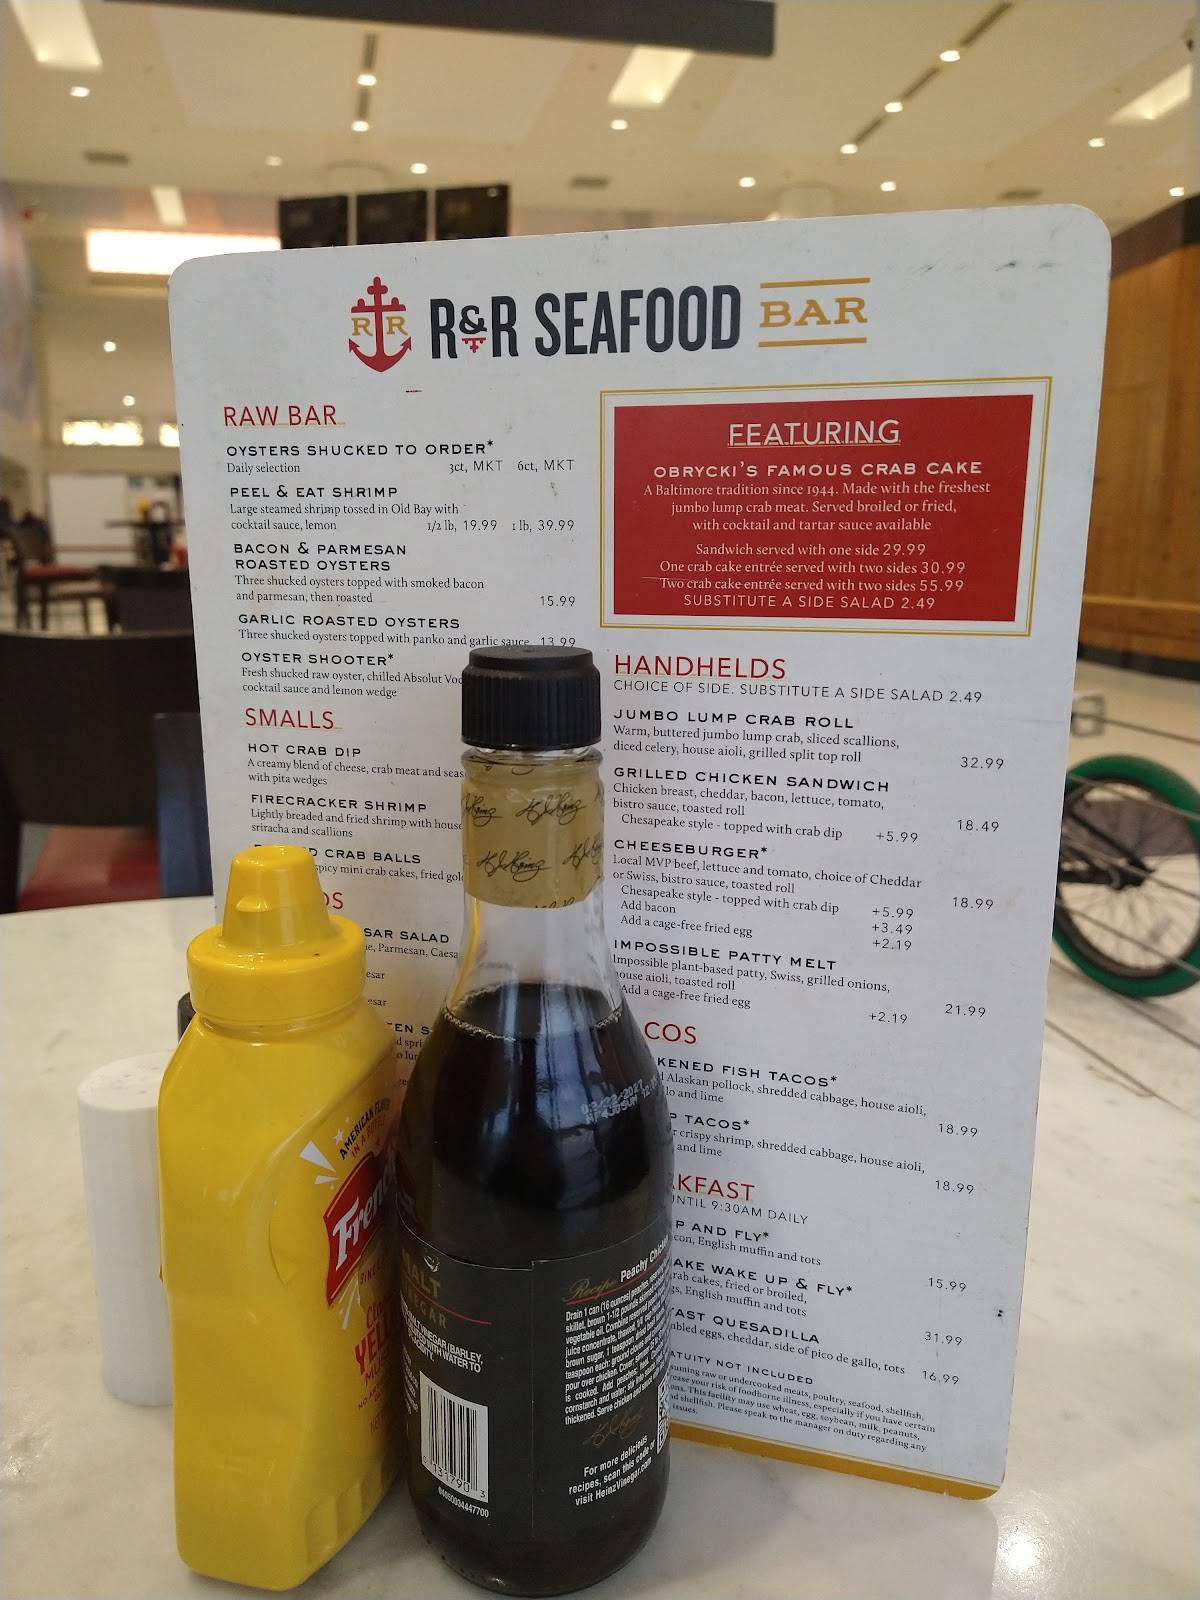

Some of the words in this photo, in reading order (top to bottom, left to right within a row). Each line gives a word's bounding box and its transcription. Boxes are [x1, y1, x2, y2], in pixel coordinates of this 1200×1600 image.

[352, 317, 373, 336] R
[386, 316, 408, 335] R
[429, 295, 519, 359] R&R
[534, 284, 741, 357] SEAFOOD
[759, 296, 868, 328] BAR
[223, 405, 279, 427] RAW
[288, 404, 337, 426] BAR
[729, 420, 899, 446] FEATURING
[226, 445, 300, 456] OYSTERS
[307, 444, 388, 456] SHUCKED
[394, 444, 417, 455] TO
[226, 461, 254, 476] Daily
[255, 461, 300, 473] selection
[449, 461, 468, 474] 3ct,
[473, 459, 502, 471] MKT
[517, 460, 538, 472] 6ct,
[544, 458, 574, 471] MKT
[653, 463, 758, 478] OBRYCKI'S
[767, 463, 852, 477] FAMOUS
[860, 462, 916, 476] CRAB
[926, 461, 981, 475] CAKE
[230, 487, 270, 498] PEEL
[276, 484, 288, 498] &
[296, 487, 325, 498] EAT
[332, 487, 397, 498] SHRIMP
[643, 484, 652, 496] A
[656, 483, 715, 496] Baltimore
[716, 482, 770, 496] tradition
[770, 483, 804, 496] since
[806, 485, 838, 497] 1944.
[842, 481, 878, 495] Made
[880, 480, 910, 494] with
[913, 480, 935, 494] the
[938, 479, 990, 494] freshest
[230, 503, 258, 517] Large
[260, 502, 302, 514] steamed
[304, 502, 341, 517] shrimp
[343, 502, 375, 514] tossed
[377, 503, 388, 514] in
[390, 503, 410, 514] Old
[413, 503, 432, 517] Bay
[434, 503, 459, 515] with
[427, 519, 442, 533] 1/2
[444, 519, 457, 532] lb,
[463, 519, 497, 531] 19.99
[233, 543, 289, 554] BACON
[297, 541, 309, 554] &
[317, 544, 406, 555] PARMESAN
[695, 543, 753, 555] Sandwich
[755, 543, 795, 556] served
[797, 543, 826, 556] with
[828, 546, 852, 556] one
[854, 543, 880, 556] side
[882, 543, 926, 556] 29.99
[235, 559, 309, 570] ROASTED
[316, 559, 390, 571] OYSTERS
[540, 595, 575, 607] 15.99
[683, 593, 776, 607] SUBSTITUTE
[781, 595, 792, 607] A
[798, 595, 834, 608] SIDE
[840, 595, 894, 609] SALAD
[900, 596, 935, 609] 2.49
[238, 613, 295, 625] GARLIC
[302, 615, 378, 627] ROASTED
[384, 617, 460, 629] OYSTERS
[241, 652, 302, 663] OYSTER
[615, 654, 785, 679] HANDHELDS
[613, 679, 668, 692] CHOICE
[673, 681, 692, 693] OF
[698, 682, 734, 694] SIDE.
[739, 683, 829, 698] SUBSTITUTE
[834, 687, 845, 698] A
[850, 687, 885, 700] SIDE
[890, 688, 943, 702] SALAD
[948, 690, 982, 703] 2.49
[245, 707, 334, 730] SMALLS
[613, 708, 678, 721] JUMBO
[687, 711, 737, 724] LUMP
[745, 714, 795, 726] CRAB
[805, 716, 853, 729] ROLL
[613, 724, 650, 738] Warm,
[653, 725, 700, 739] buttered
[702, 728, 740, 742] jumbo
[742, 729, 773, 745] lump
[775, 731, 804, 745] crab,
[806, 732, 840, 745] sliced
[843, 734, 899, 749] scallions,
[248, 743, 279, 754] HOT
[285, 744, 327, 756] CRAB
[334, 747, 360, 757] DIP
[960, 756, 1004, 770] 32.99
[614, 767, 687, 781] GRILLED
[695, 771, 777, 786] CHICKEN
[786, 776, 888, 792] SANDWICH
[251, 793, 357, 809] FIRECRACKER
[364, 800, 426, 813] SHRIMP
[957, 819, 999, 832] 18.49
[876, 830, 918, 843] +5.99
[324, 848, 366, 860] CRAB
[373, 851, 421, 864] BALLS
[952, 896, 994, 910] 18.99
[872, 922, 913, 935] +3.49
[399, 930, 449, 944] SALAD
[614, 939, 720, 959] IMPOSSIBLE
[728, 950, 782, 965] PATTY
[790, 956, 836, 971] MELT
[944, 1003, 986, 1018] 21.99
[644, 1021, 696, 1044] COS
[657, 1057, 714, 1072] KENED
[722, 1065, 760, 1079] FISH
[938, 1123, 978, 1137] 18.99
[673, 1173, 755, 1202] KFAST
[711, 1200, 762, 1217] 9:30AM
[767, 1209, 808, 1225] DAILY
[691, 1223, 726, 1237] AND
[697, 1235, 736, 1251] English
[739, 1245, 774, 1258] muffin
[777, 1251, 797, 1262] and
[800, 1255, 821, 1266] tots
[620, 1258, 649, 1282] Peachy
[711, 1264, 757, 1281] WAKE
[765, 1273, 788, 1285] UP
[795, 1277, 808, 1290] &
[928, 1277, 966, 1292] 15.99
[712, 1315, 820, 1344] QUESADILLA
[924, 1330, 963, 1346] 31.99
[716, 1359, 741, 1370] NOT
[747, 1365, 813, 1385] INCLUDED
[922, 1370, 959, 1385] 16.99
[584, 1466, 598, 1477] For
[600, 1456, 619, 1471] more
[620, 1435, 648, 1461] delicious
[568, 1479, 602, 1494] recipes,
[603, 1469, 620, 1483] scan
[622, 1459, 635, 1473] this
[635, 1446, 650, 1463] code
[649, 1439, 656, 1450] or
[575, 1493, 594, 1506] visit
[595, 1457, 652, 1499] HeinzVinegar.com
